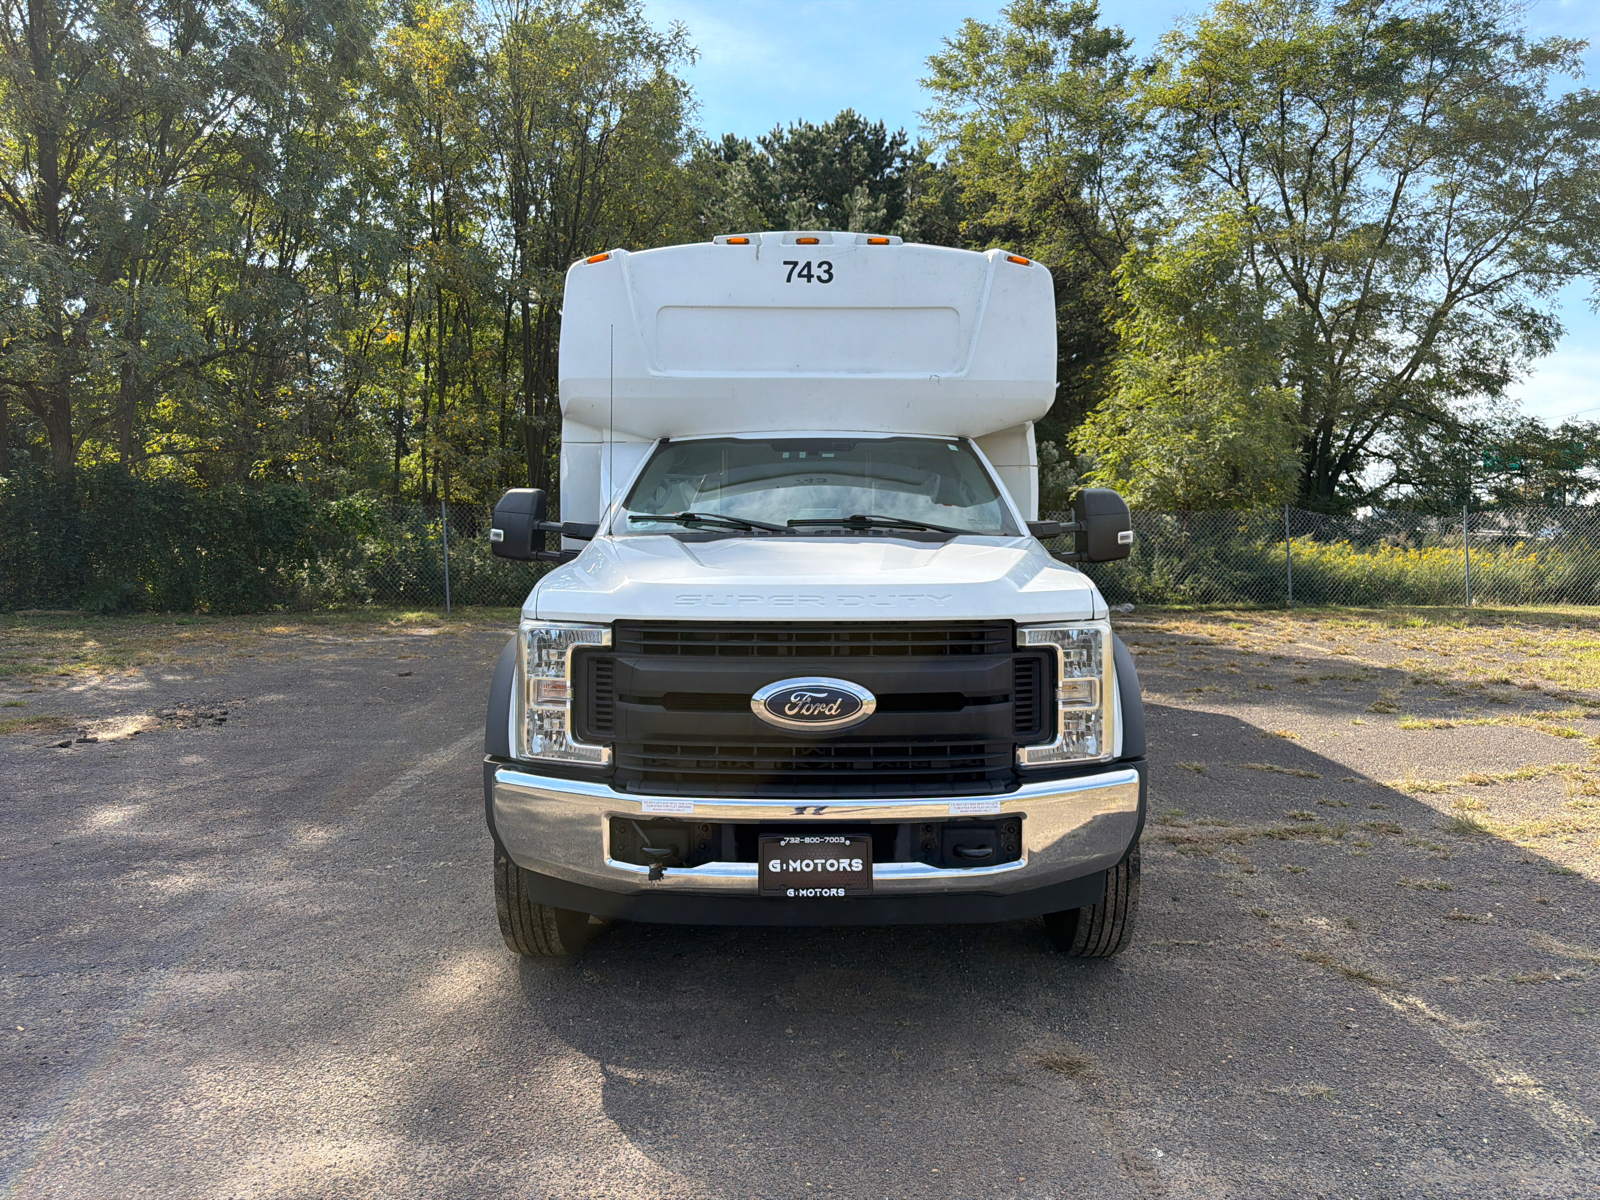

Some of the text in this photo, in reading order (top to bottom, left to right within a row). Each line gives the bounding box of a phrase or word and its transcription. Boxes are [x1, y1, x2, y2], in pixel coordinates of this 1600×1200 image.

[783, 260, 834, 284] 743
[674, 594, 952, 607] SUPER DUTY
[784, 691, 842, 716] Ford
[784, 836, 845, 844] 732-800-7003
